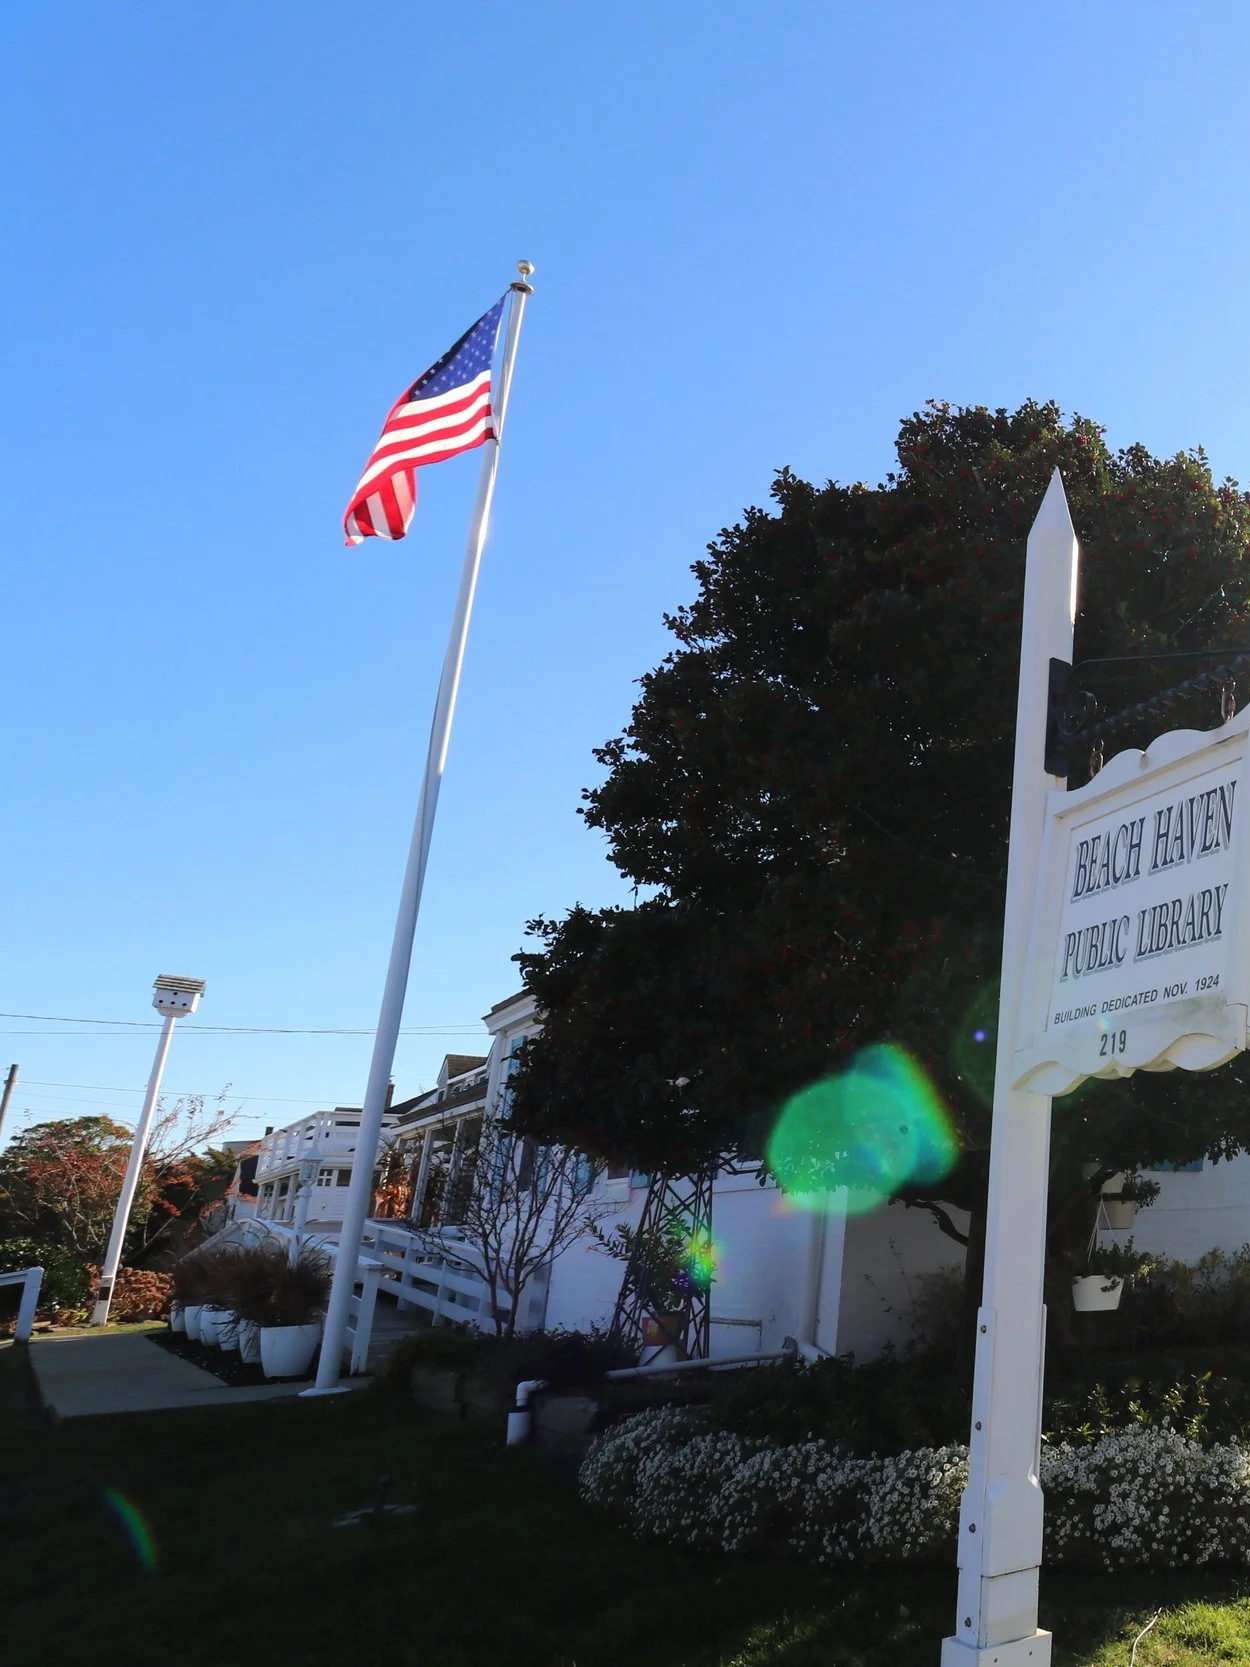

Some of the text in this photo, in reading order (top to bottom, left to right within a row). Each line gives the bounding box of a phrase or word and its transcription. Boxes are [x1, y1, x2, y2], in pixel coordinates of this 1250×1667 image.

[1071, 780, 1238, 902] BEACH HAVEN
[1061, 882, 1229, 981] PUBLIC LIBRARY
[1054, 973, 1220, 1025] BUILDING DEDICATED NOV. 1924
[1100, 1029, 1128, 1057] 219
